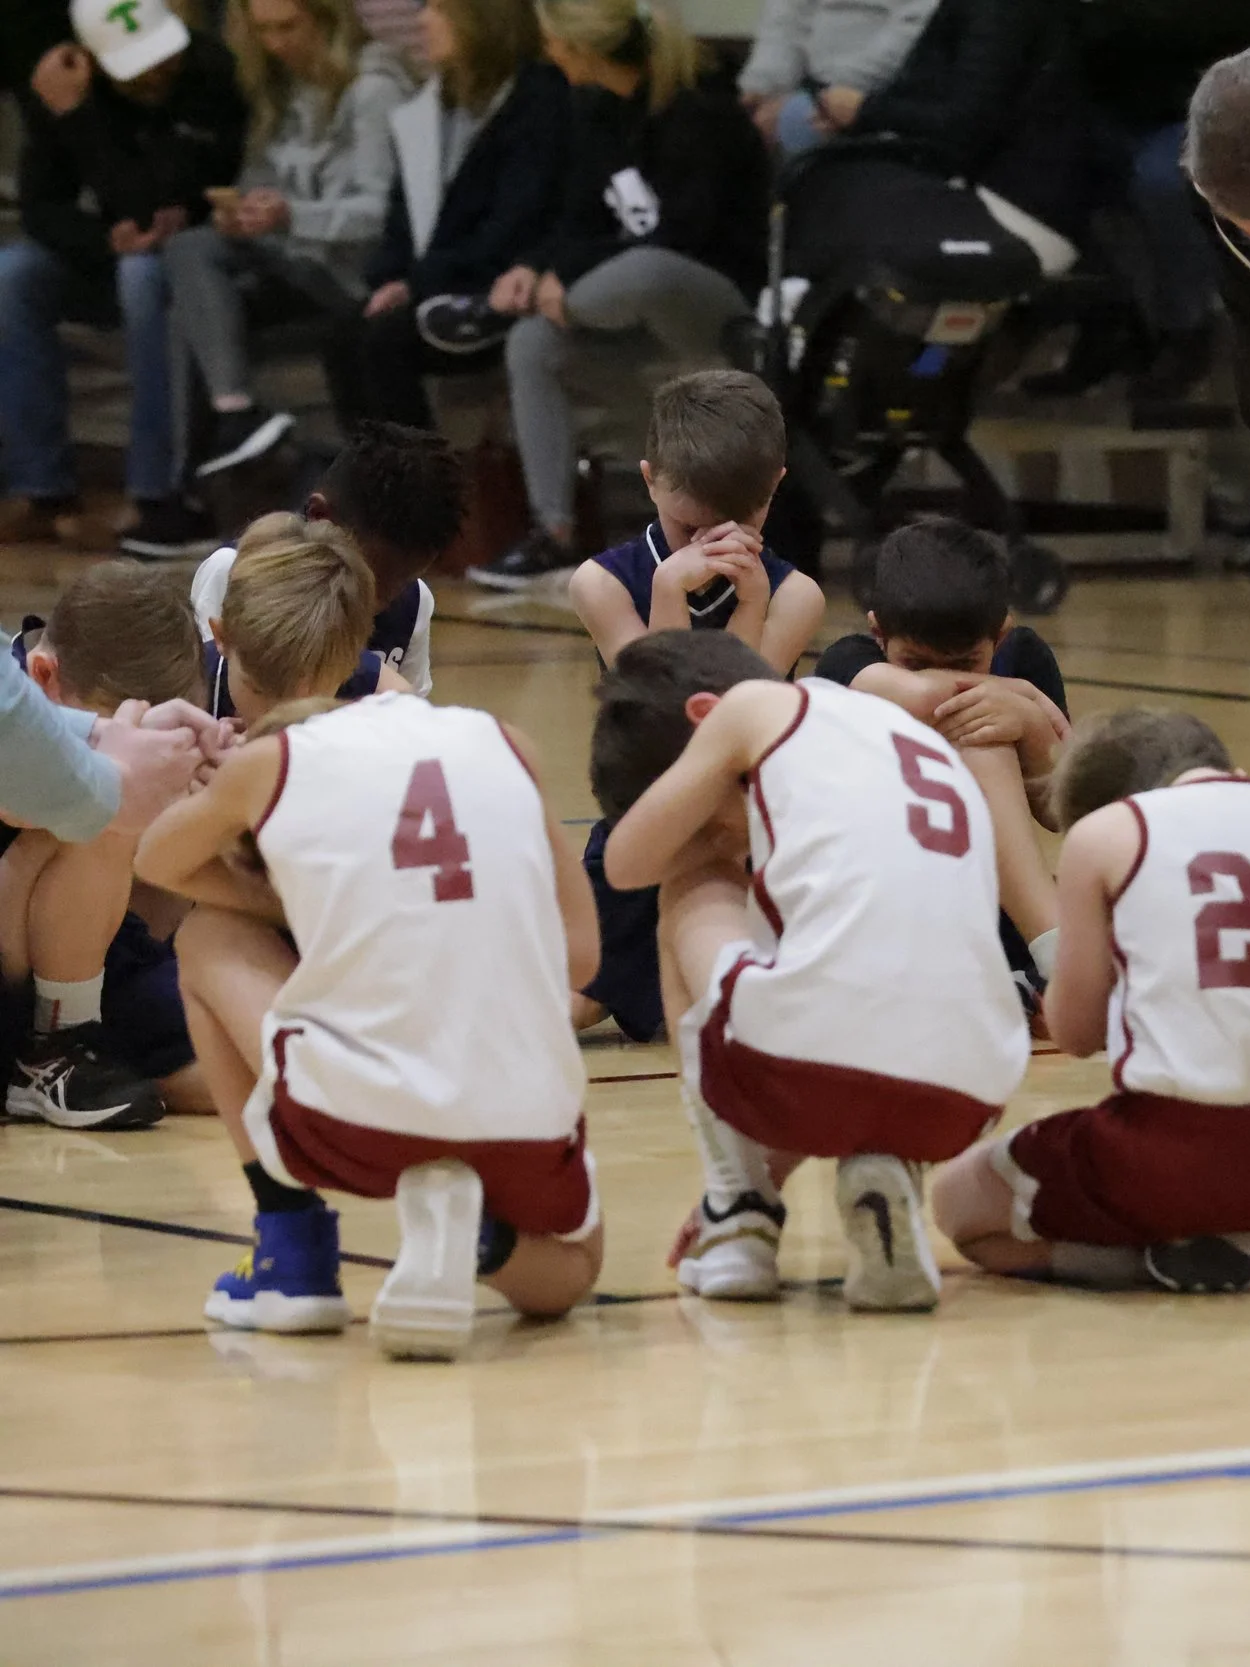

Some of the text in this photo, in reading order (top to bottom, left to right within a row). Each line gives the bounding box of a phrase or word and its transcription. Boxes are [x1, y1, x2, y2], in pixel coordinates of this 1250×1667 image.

[106, 1, 139, 33] T
[391, 758, 474, 902] 4
[890, 730, 970, 859] 5
